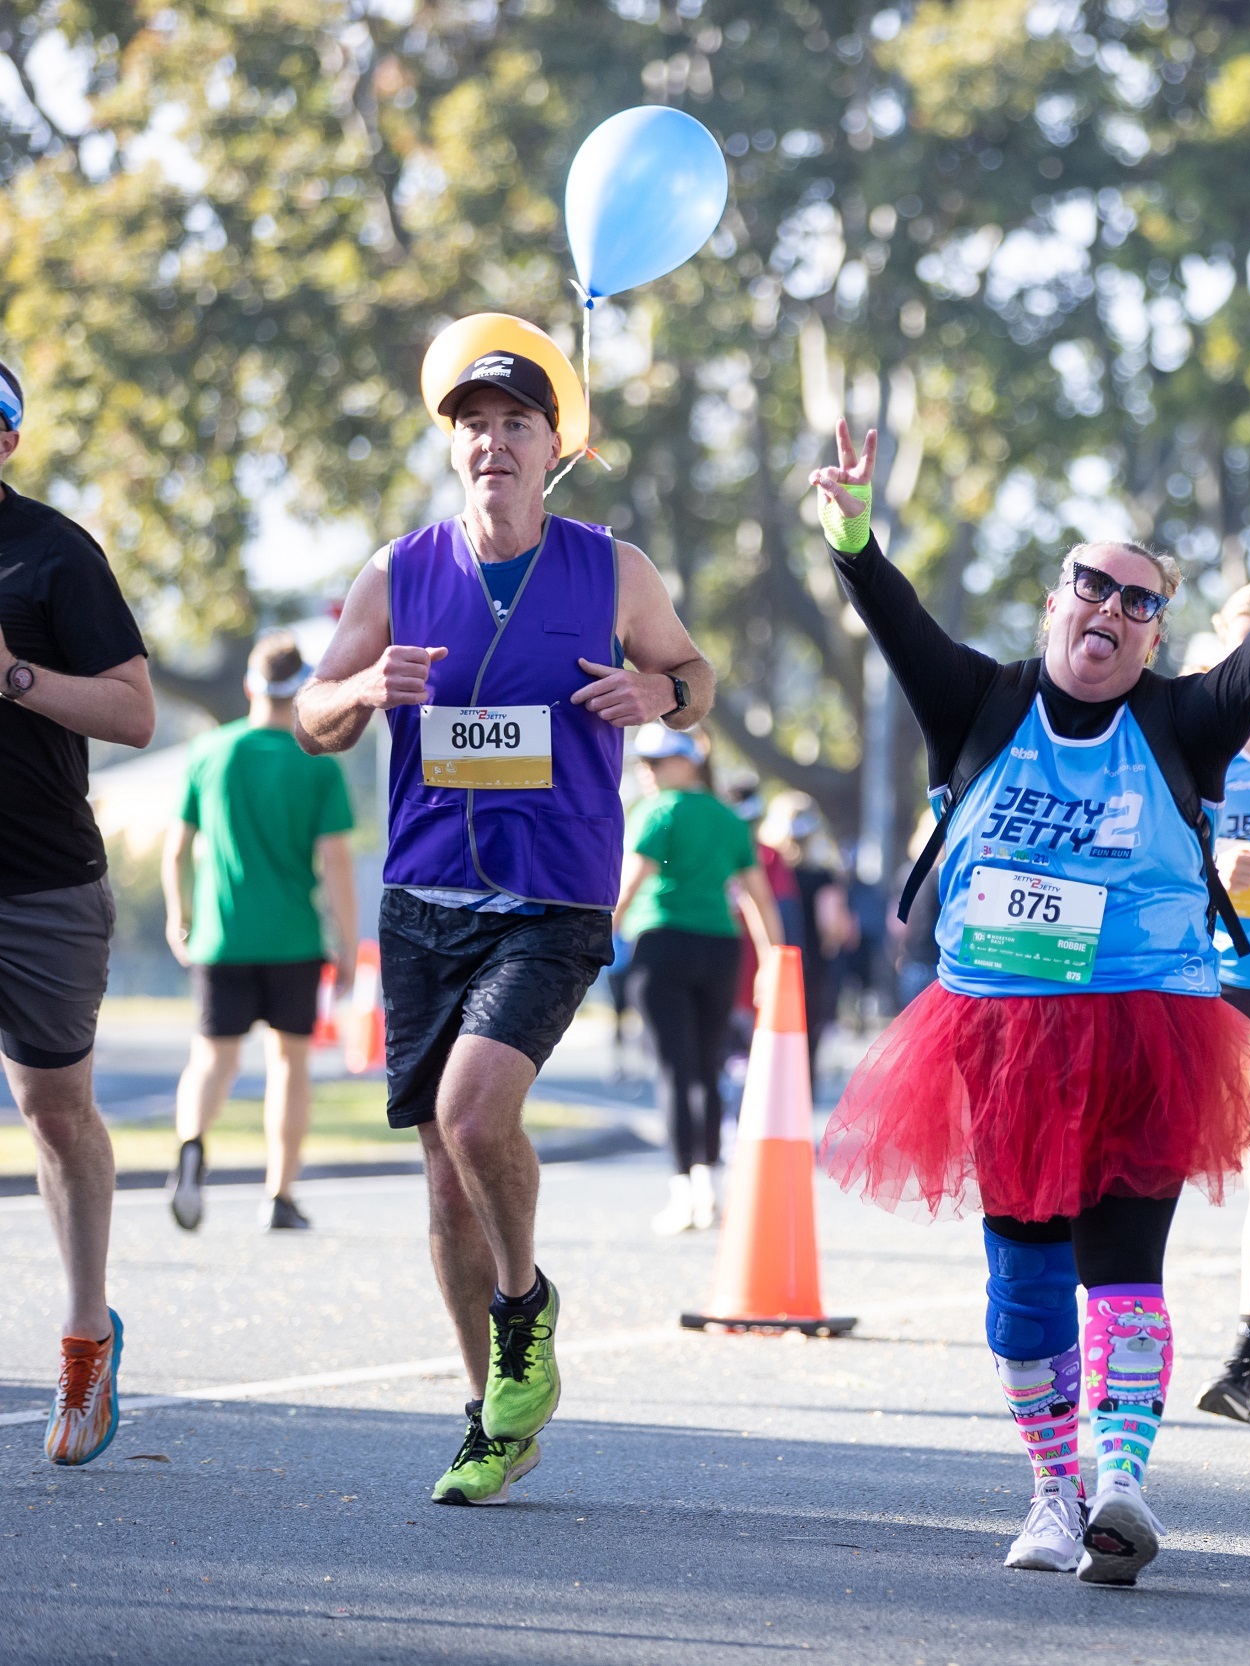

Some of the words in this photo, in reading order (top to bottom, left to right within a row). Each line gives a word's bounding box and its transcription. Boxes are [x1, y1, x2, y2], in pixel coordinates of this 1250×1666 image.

[478, 709, 488, 720] 2
[451, 722, 521, 749] 8049
[1010, 746, 1039, 760] ebel
[994, 785, 1105, 824] JETTY
[1093, 789, 1143, 850] 2
[981, 812, 1097, 854] JETTY
[1092, 848, 1109, 857] FUN
[1111, 849, 1130, 858] RUN
[1013, 874, 1034, 883] JETTY
[1030, 878, 1042, 889] 2
[1038, 883, 1062, 892] JETTY
[1008, 889, 1062, 923] 875
[991, 934, 1015, 943] MORETON
[1057, 940, 1086, 952] ROBBIE
[1065, 970, 1081, 981] 875
[1025, 1427, 1056, 1442] NO
[1122, 1418, 1150, 1436] NO
[1027, 1442, 1072, 1461] AMA
[1102, 1437, 1149, 1460] DRAM
[1038, 1464, 1066, 1477] AD
